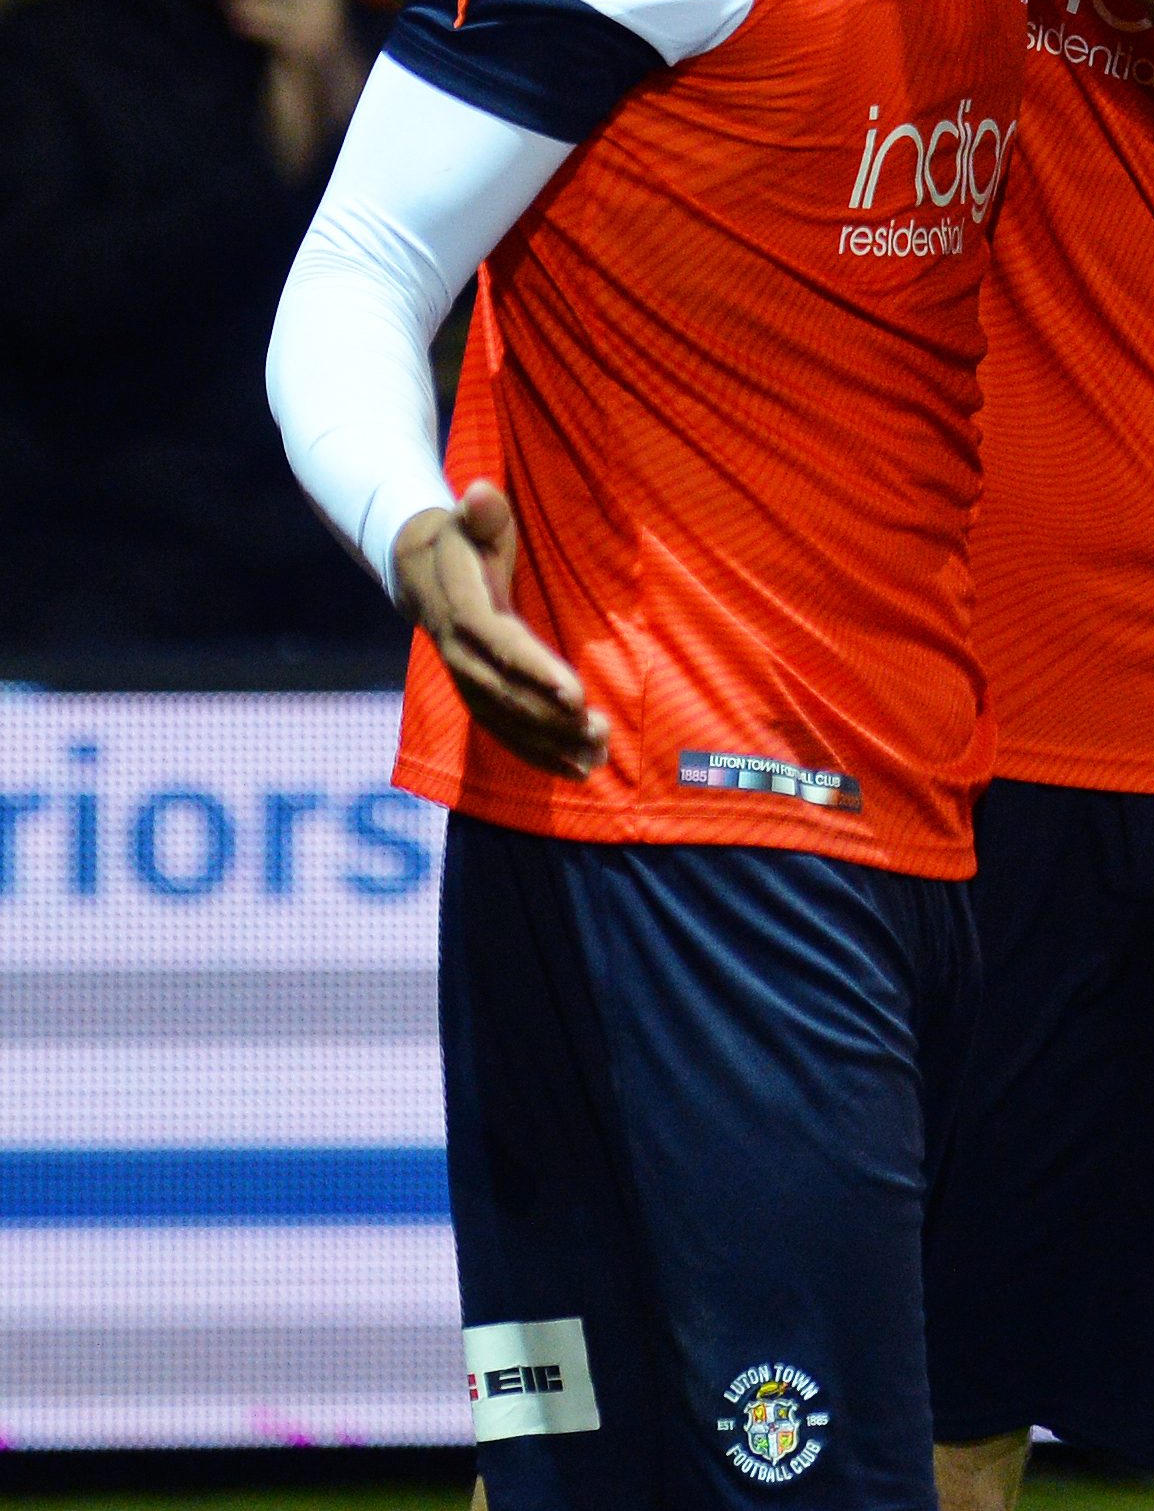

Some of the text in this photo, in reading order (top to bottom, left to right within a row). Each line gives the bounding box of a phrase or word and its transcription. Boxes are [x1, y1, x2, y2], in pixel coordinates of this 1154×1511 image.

[838, 216, 965, 257] residential
[681, 769, 707, 782] 1885
[709, 755, 745, 769] LUTON
[747, 758, 780, 774] TOWN
[815, 773, 840, 787] CLUB
[723, 1363, 820, 1403] LUTON TOWN
[717, 1419, 734, 1430] EST
[726, 1440, 821, 1482] FOOTBALL CLUB
